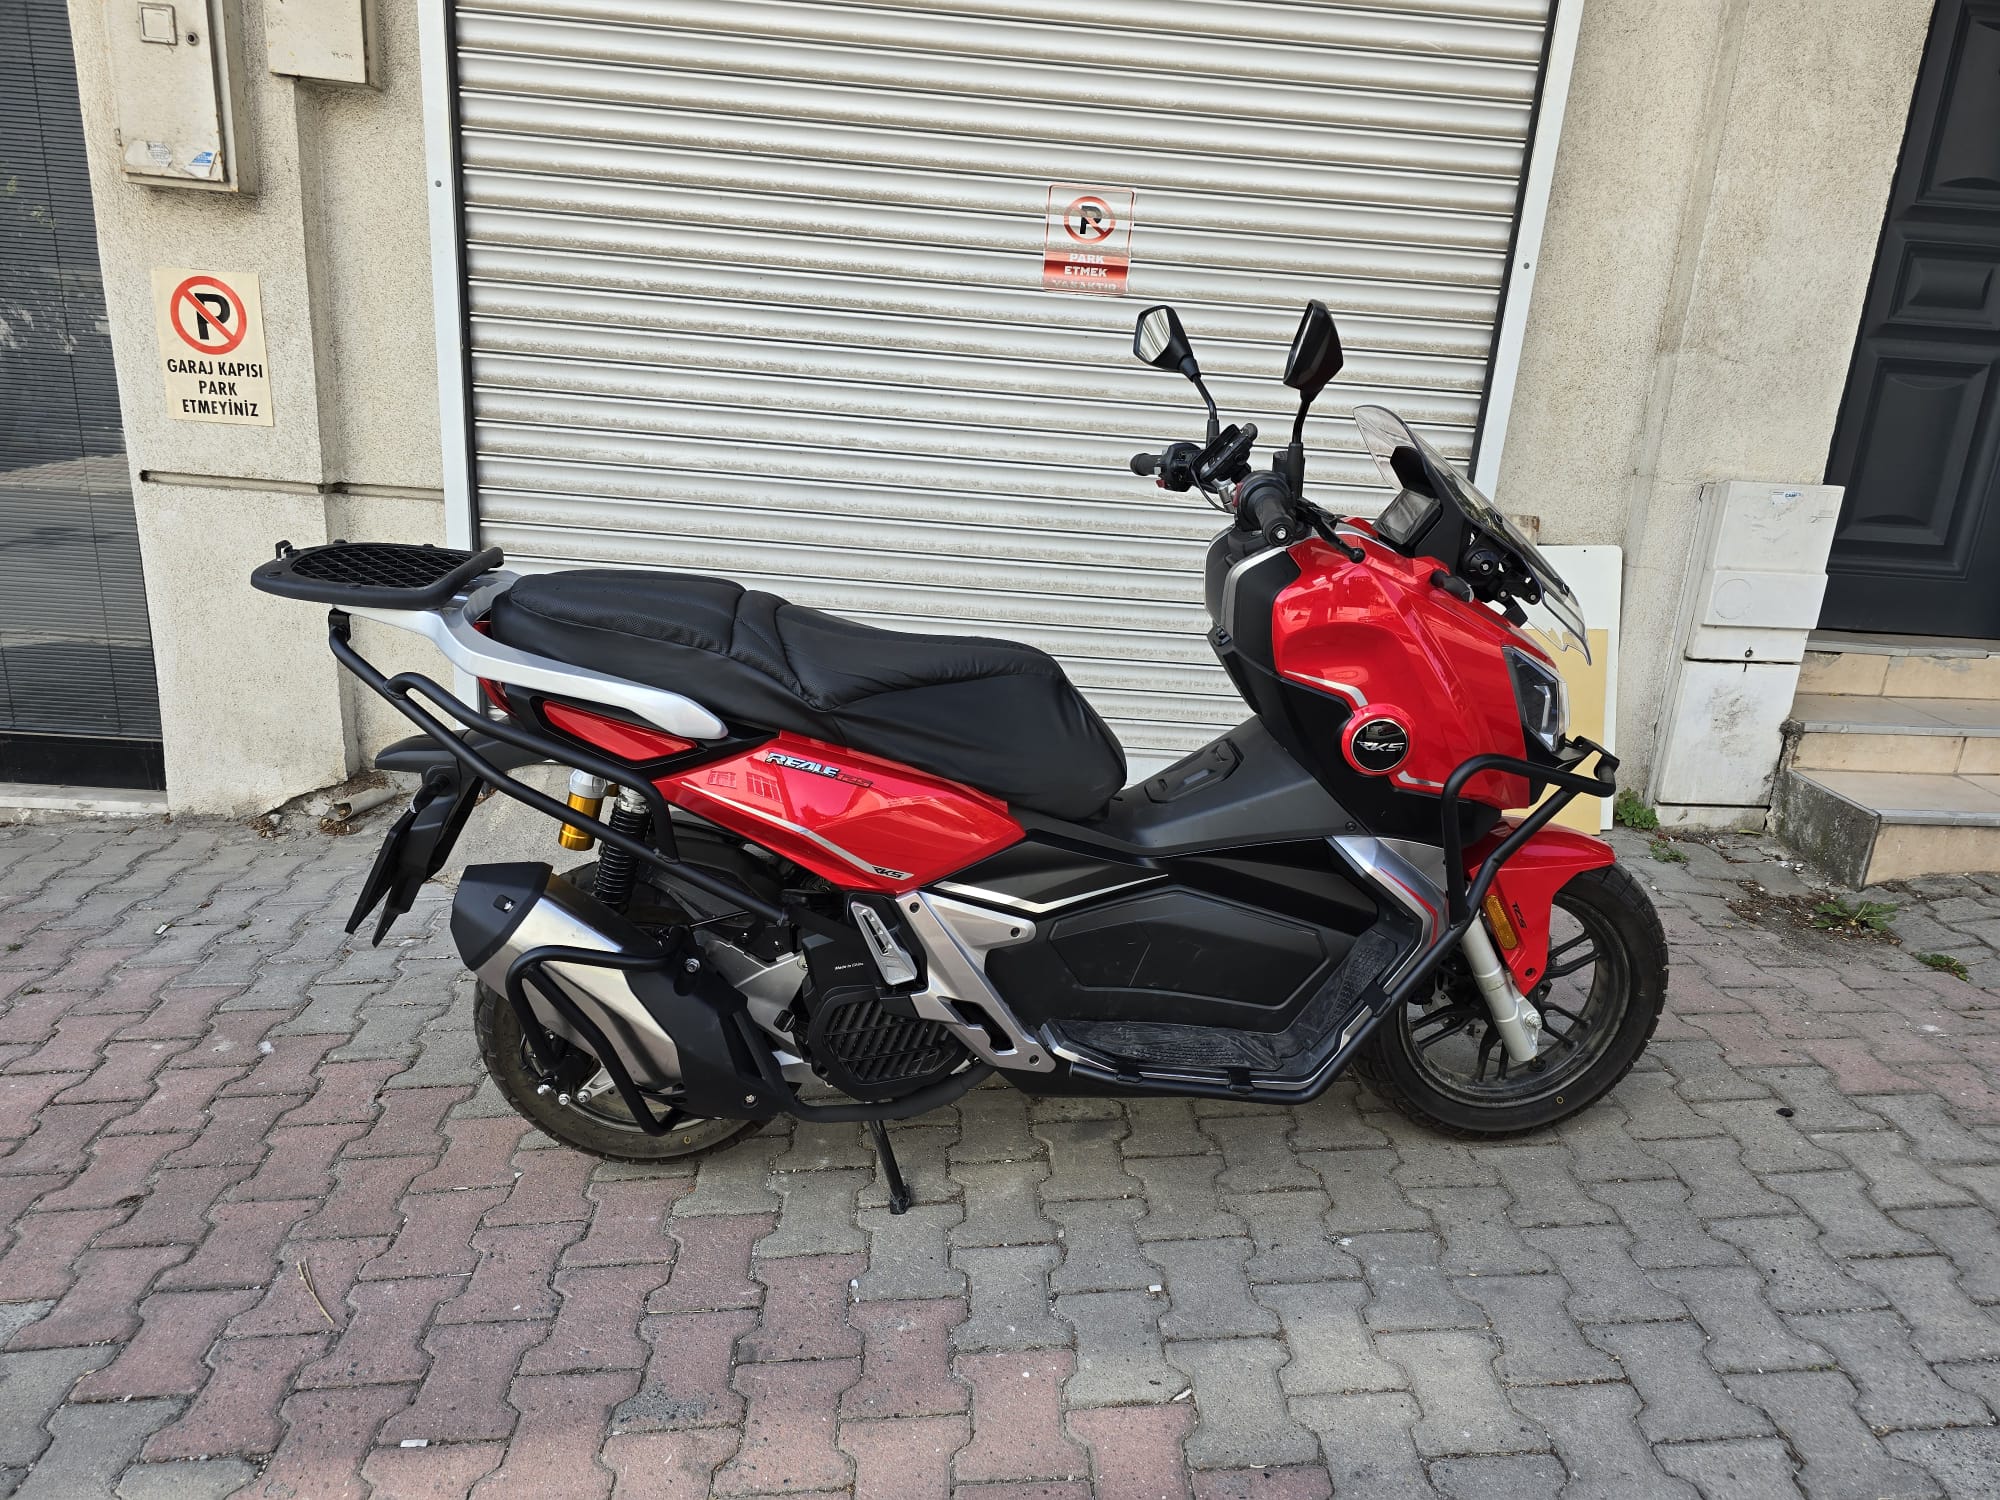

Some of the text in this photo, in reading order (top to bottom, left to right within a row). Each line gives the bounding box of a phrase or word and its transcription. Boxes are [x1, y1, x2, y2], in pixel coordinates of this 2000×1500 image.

[1069, 253, 1105, 264] PARK
[1064, 265, 1108, 278] ETMEK
[167, 359, 263, 378] GARAJ KAPISI
[199, 380, 238, 396] PARK
[182, 398, 259, 417] ETMEYİNİZ
[1357, 740, 1405, 752] RKS
[765, 752, 841, 779] REALE
[872, 865, 904, 879] RKS
